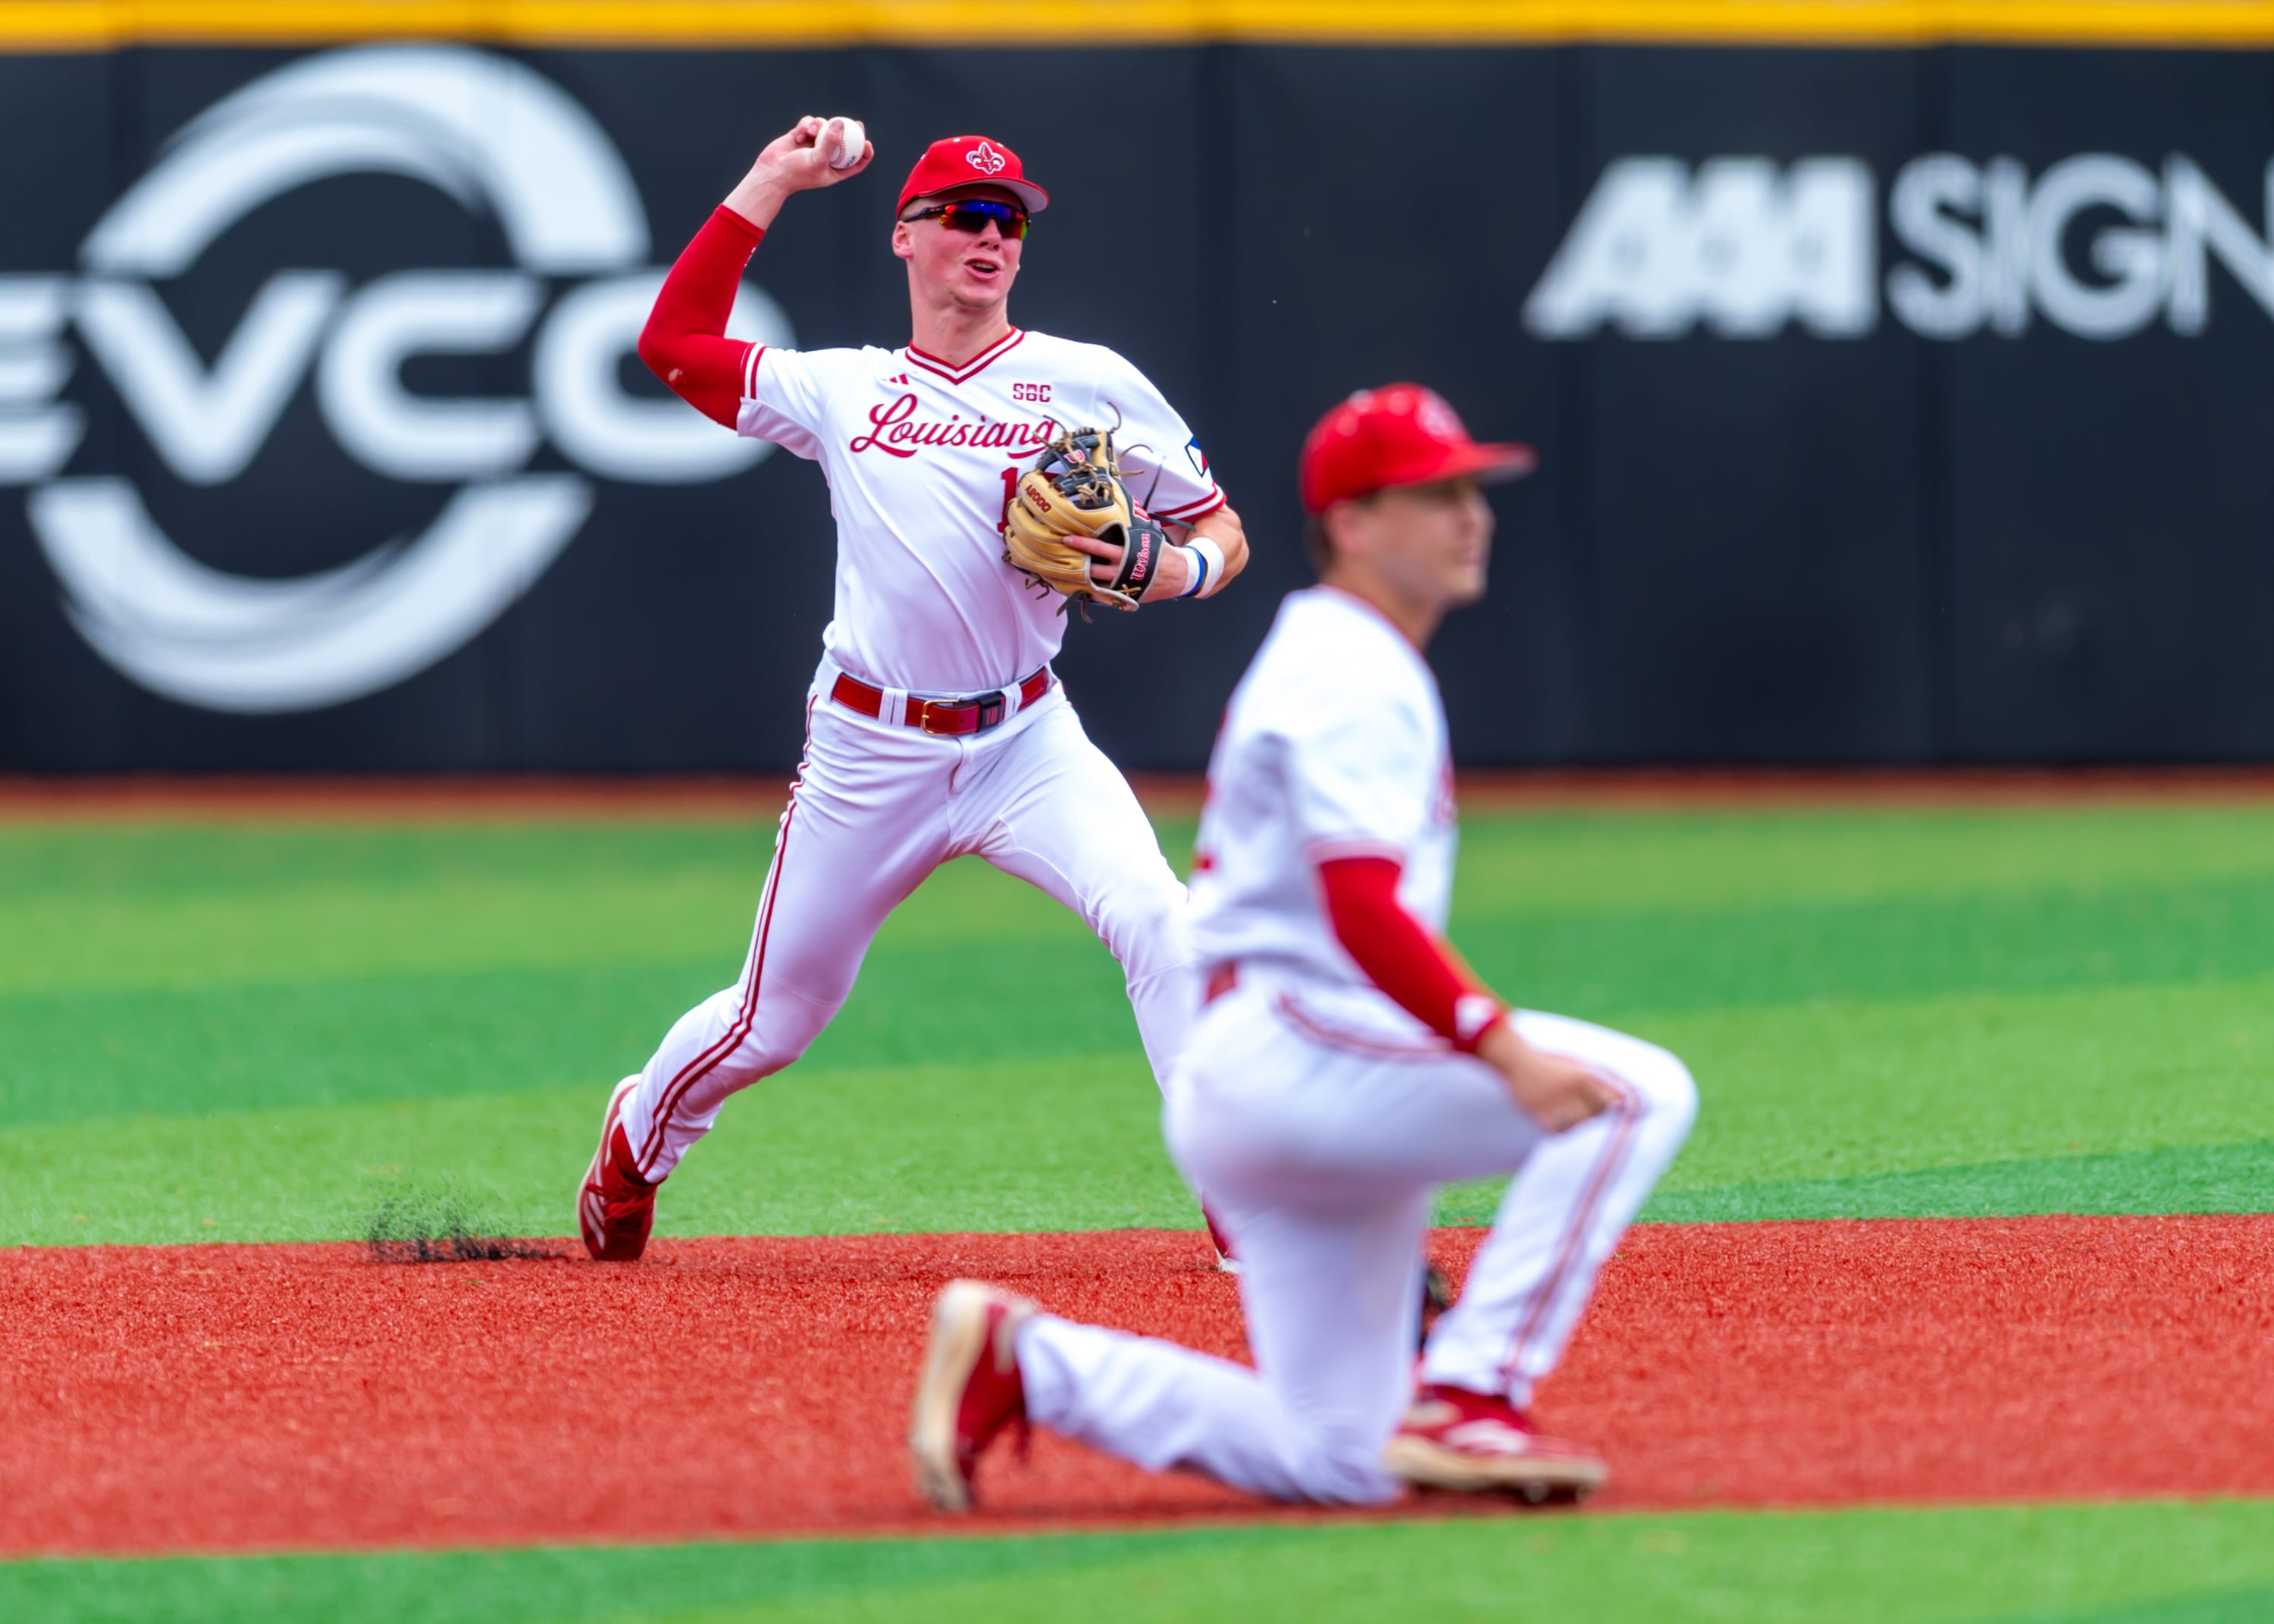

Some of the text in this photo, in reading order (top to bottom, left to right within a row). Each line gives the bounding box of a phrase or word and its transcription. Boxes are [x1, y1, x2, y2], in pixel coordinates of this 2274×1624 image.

[1522, 150, 2274, 341] AAA SIGN
[1013, 383, 1052, 403] SBC
[850, 393, 1057, 459] Louisiana
[1130, 533, 1151, 580] Wilson
